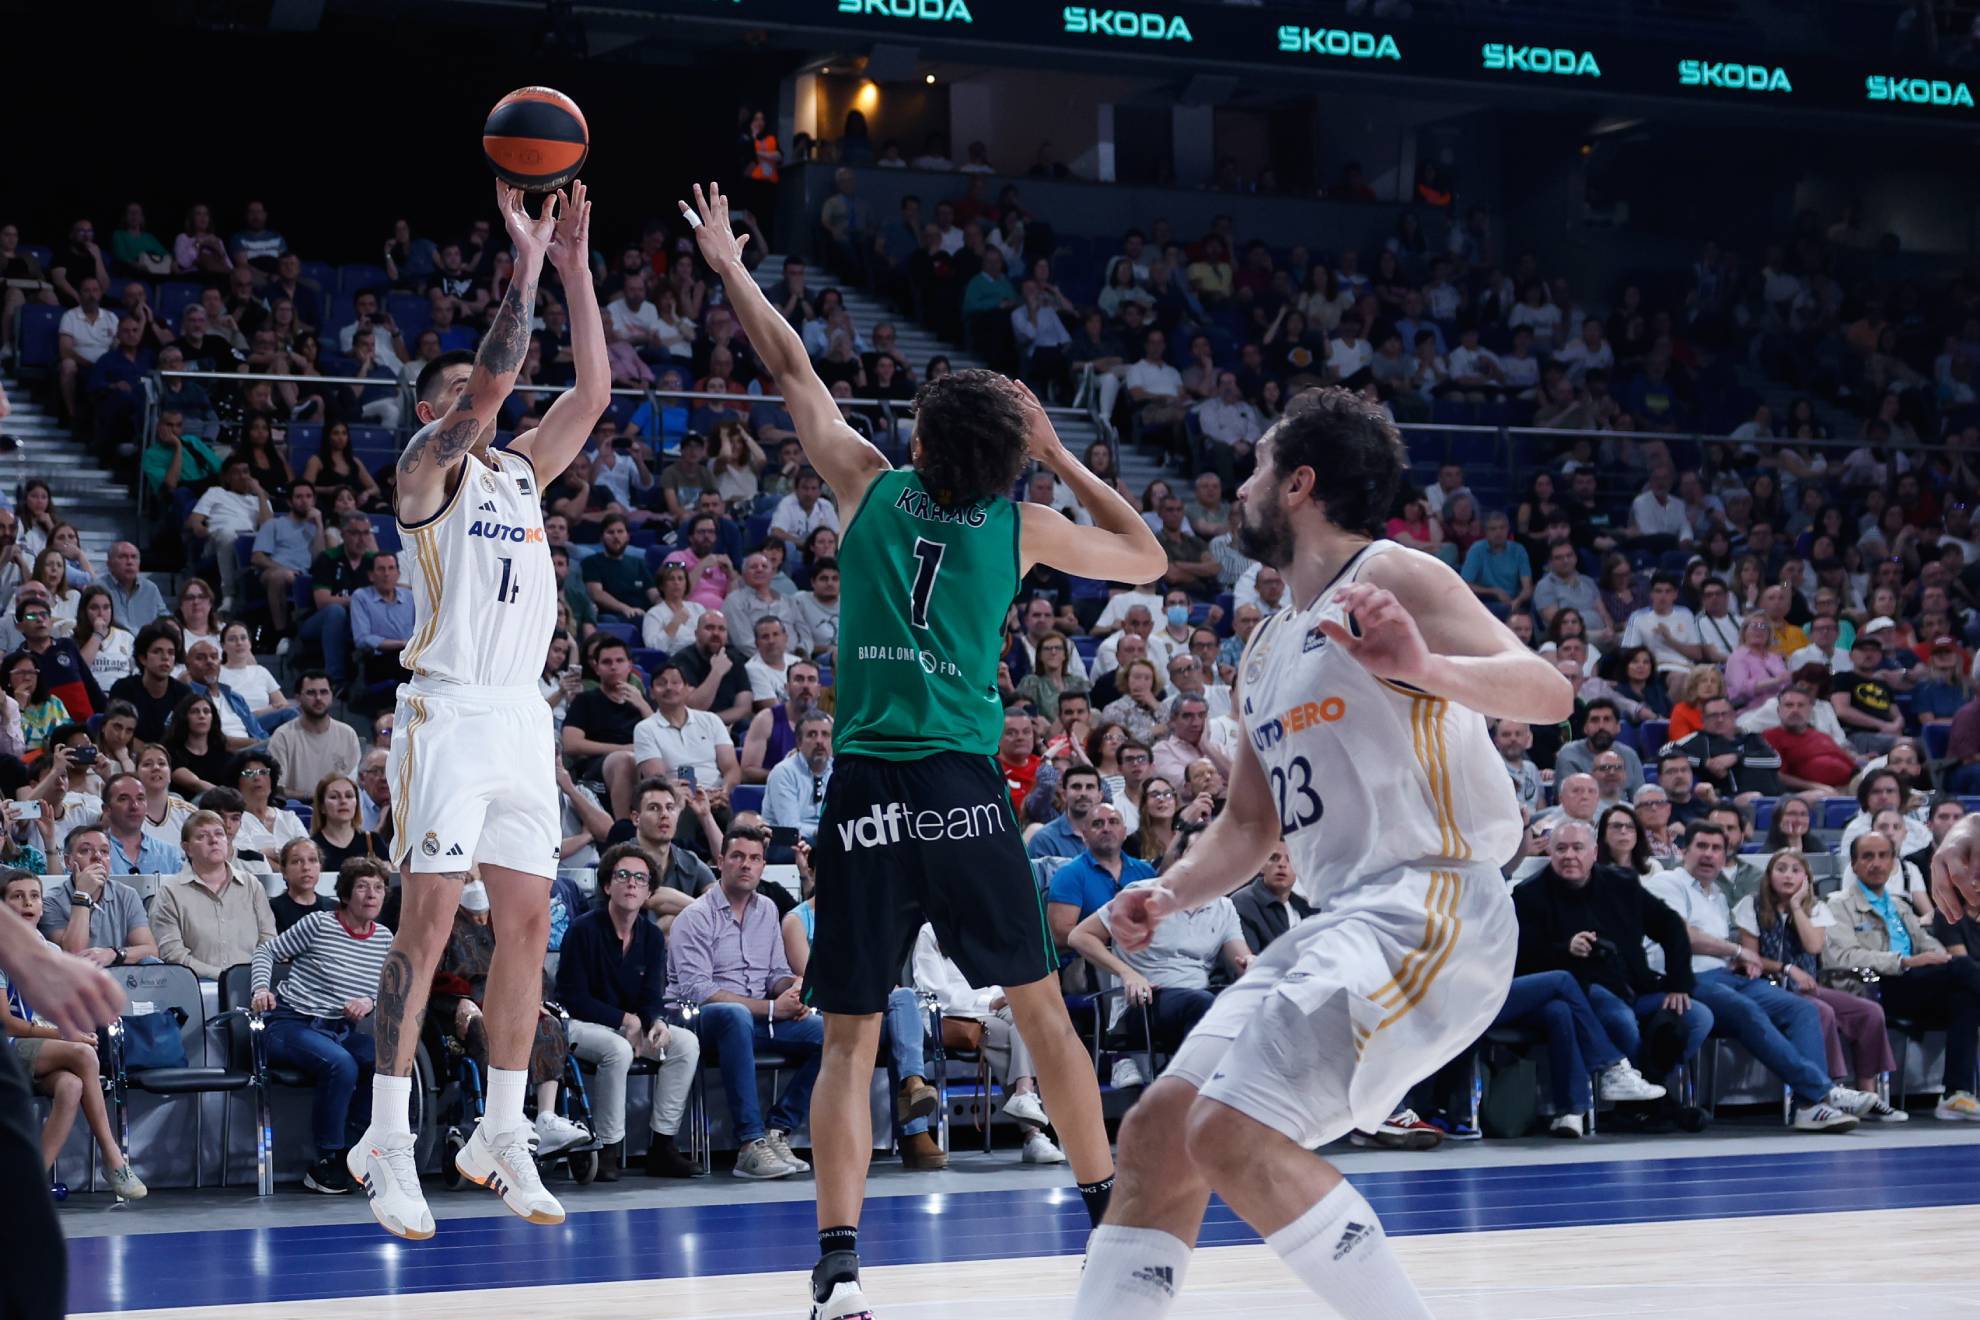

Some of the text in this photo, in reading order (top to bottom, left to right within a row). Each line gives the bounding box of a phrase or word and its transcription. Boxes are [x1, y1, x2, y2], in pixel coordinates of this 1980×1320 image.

[910, 536, 946, 631] 1
[858, 645, 915, 662] BADALONA
[1271, 755, 1324, 837] 23
